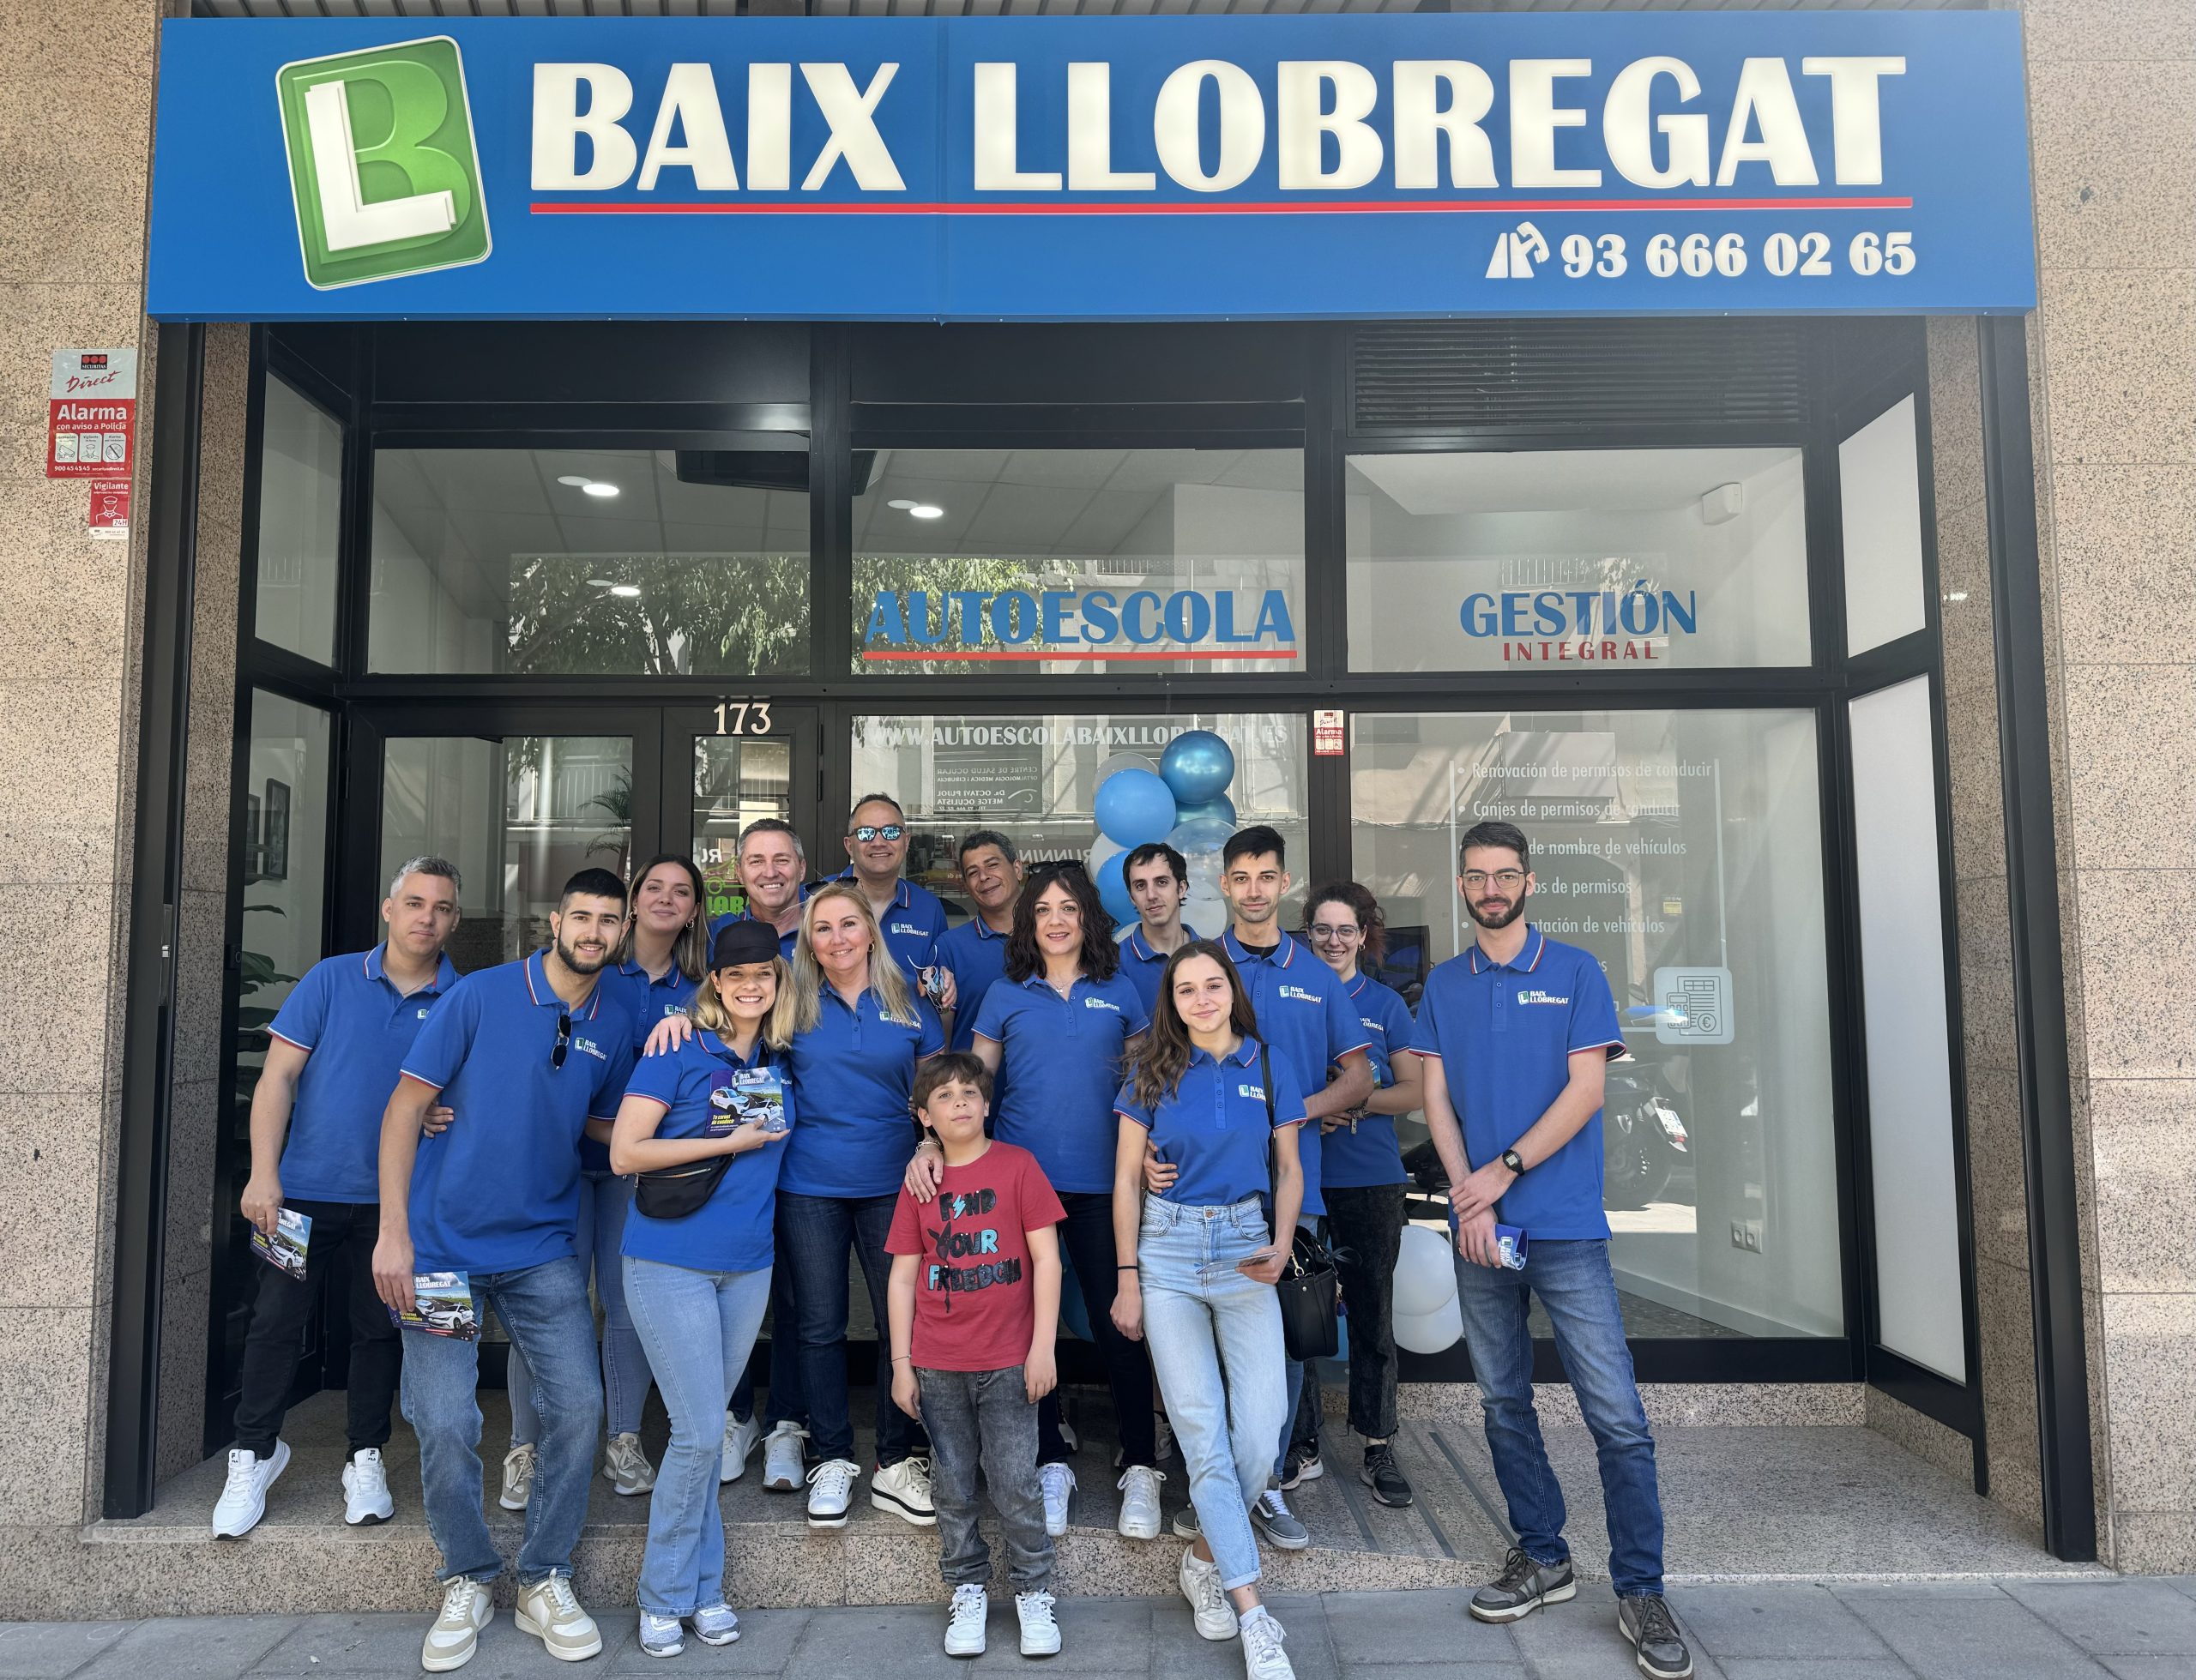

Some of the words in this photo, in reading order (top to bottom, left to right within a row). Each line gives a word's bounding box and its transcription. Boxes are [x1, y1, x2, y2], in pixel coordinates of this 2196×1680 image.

[530, 62, 908, 192] BAIX
[974, 56, 1907, 192] LLOBREGAT
[1560, 233, 1628, 278] 93
[1645, 233, 1748, 278] 666
[1763, 232, 1832, 277] 02
[1849, 232, 1916, 276] 65
[65, 370, 123, 393] Direct
[57, 403, 127, 420] Alarma
[72, 422, 93, 431] aviso
[94, 482, 129, 491] Vigilante
[865, 588, 1296, 645] AUTOESCOLA
[1460, 579, 1697, 638] GESTIÓN
[1503, 641, 1659, 661] INTEGRAL
[713, 702, 772, 736] 173
[1472, 762, 1547, 779] Renovación
[1551, 761, 1568, 777] de
[1572, 762, 1632, 781] permisos
[1635, 761, 1652, 776] de
[1656, 759, 1712, 777] conducir
[1473, 800, 1516, 821] Canjes
[1520, 799, 1535, 816] de
[1541, 800, 1601, 820] permisos
[1604, 798, 1620, 816] de
[1529, 839, 1544, 855] de
[1548, 838, 1601, 855] nombre
[1605, 838, 1621, 855] de
[1626, 836, 1687, 855] vehículos
[1552, 876, 1568, 894] de
[1572, 878, 1632, 898] permisos
[1583, 915, 1599, 933] de
[1603, 915, 1665, 933] vehículos
[1290, 991, 1322, 1003] LLOBREGAT
[1529, 996, 1570, 1004] LLOBREGAT
[585, 1039, 598, 1049] BAIX
[927, 1221, 999, 1261] YOUR
[928, 1256, 1022, 1293] FREEDOM
